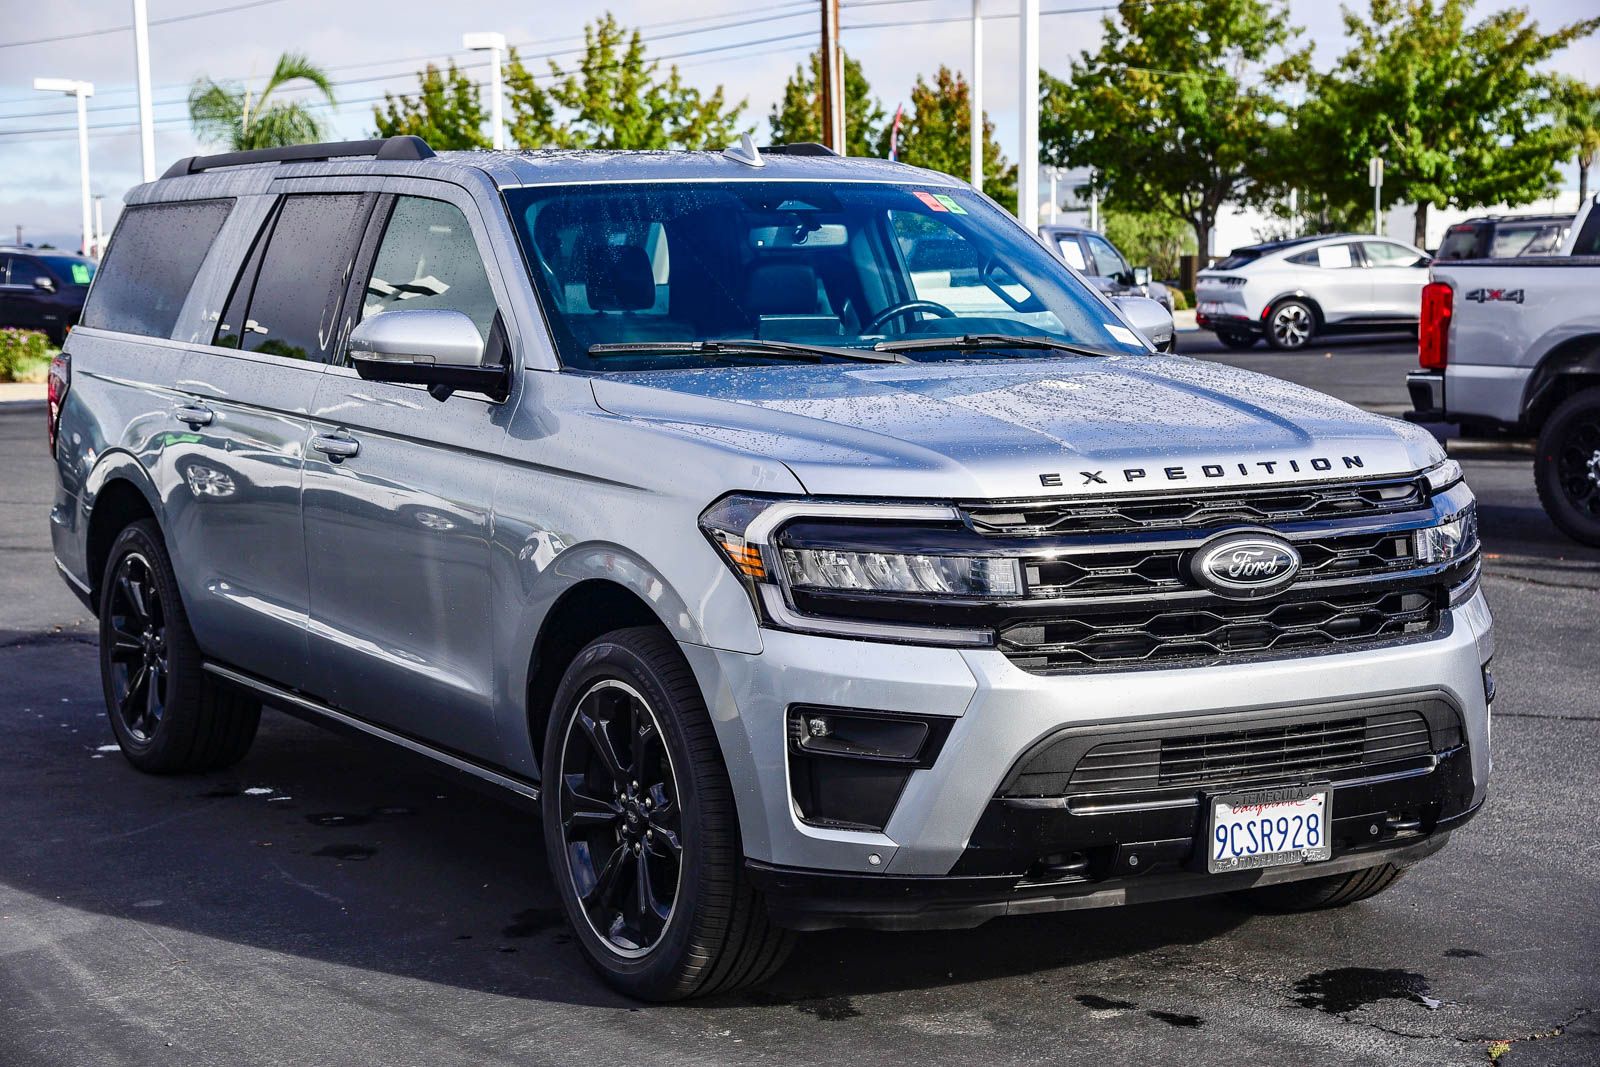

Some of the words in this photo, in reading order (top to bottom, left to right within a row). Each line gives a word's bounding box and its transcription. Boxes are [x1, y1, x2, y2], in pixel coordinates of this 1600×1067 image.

[1039, 455, 1365, 487] EXPEDITION
[1229, 550, 1278, 578] Ford
[1243, 788, 1304, 805] TEMECULA
[1215, 813, 1320, 860] 9CSR928
